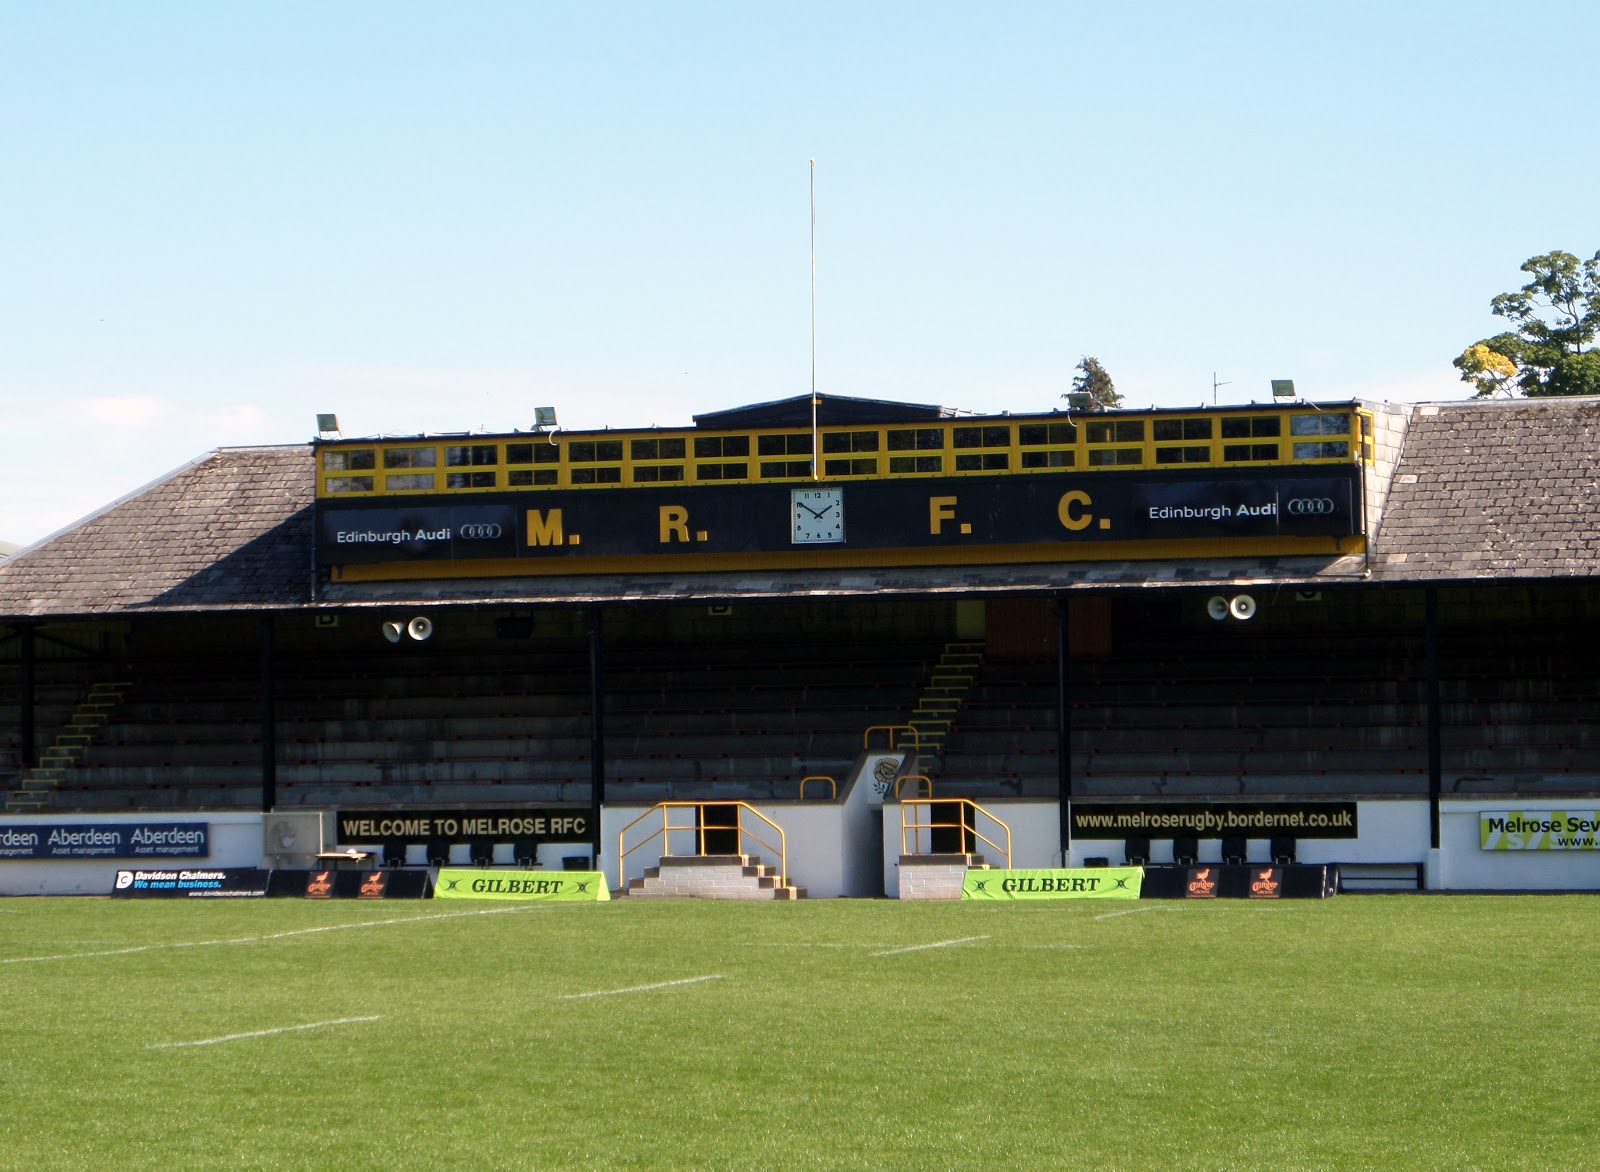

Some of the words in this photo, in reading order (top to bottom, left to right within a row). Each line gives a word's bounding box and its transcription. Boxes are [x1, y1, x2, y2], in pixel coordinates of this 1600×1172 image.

[526, 508, 580, 546] M.
[658, 505, 708, 543] R.
[929, 495, 972, 534] F.
[1057, 490, 1111, 531] C.
[1149, 504, 1231, 520] Edinburgh
[1236, 503, 1277, 516] Audi
[336, 530, 411, 544] Edinburgh
[414, 528, 450, 541] Audi
[343, 819, 430, 837] WELCOME
[434, 818, 459, 836] TO
[463, 818, 546, 836] MELROSE
[550, 817, 586, 834] RFC
[1076, 811, 1352, 831] www.melroserugby.bordernet.co.uk
[1488, 817, 1562, 833] Melrose
[47, 828, 121, 845] Aberdeen
[130, 827, 204, 844] Aberdeen
[72, 848, 116, 856] management
[156, 846, 199, 854] management
[134, 871, 177, 880] Davidson
[179, 870, 226, 880] Chalmers.
[134, 880, 148, 889] We
[177, 880, 222, 888] business.
[472, 878, 563, 894] GILBERT
[1002, 877, 1100, 892] GILBERT
